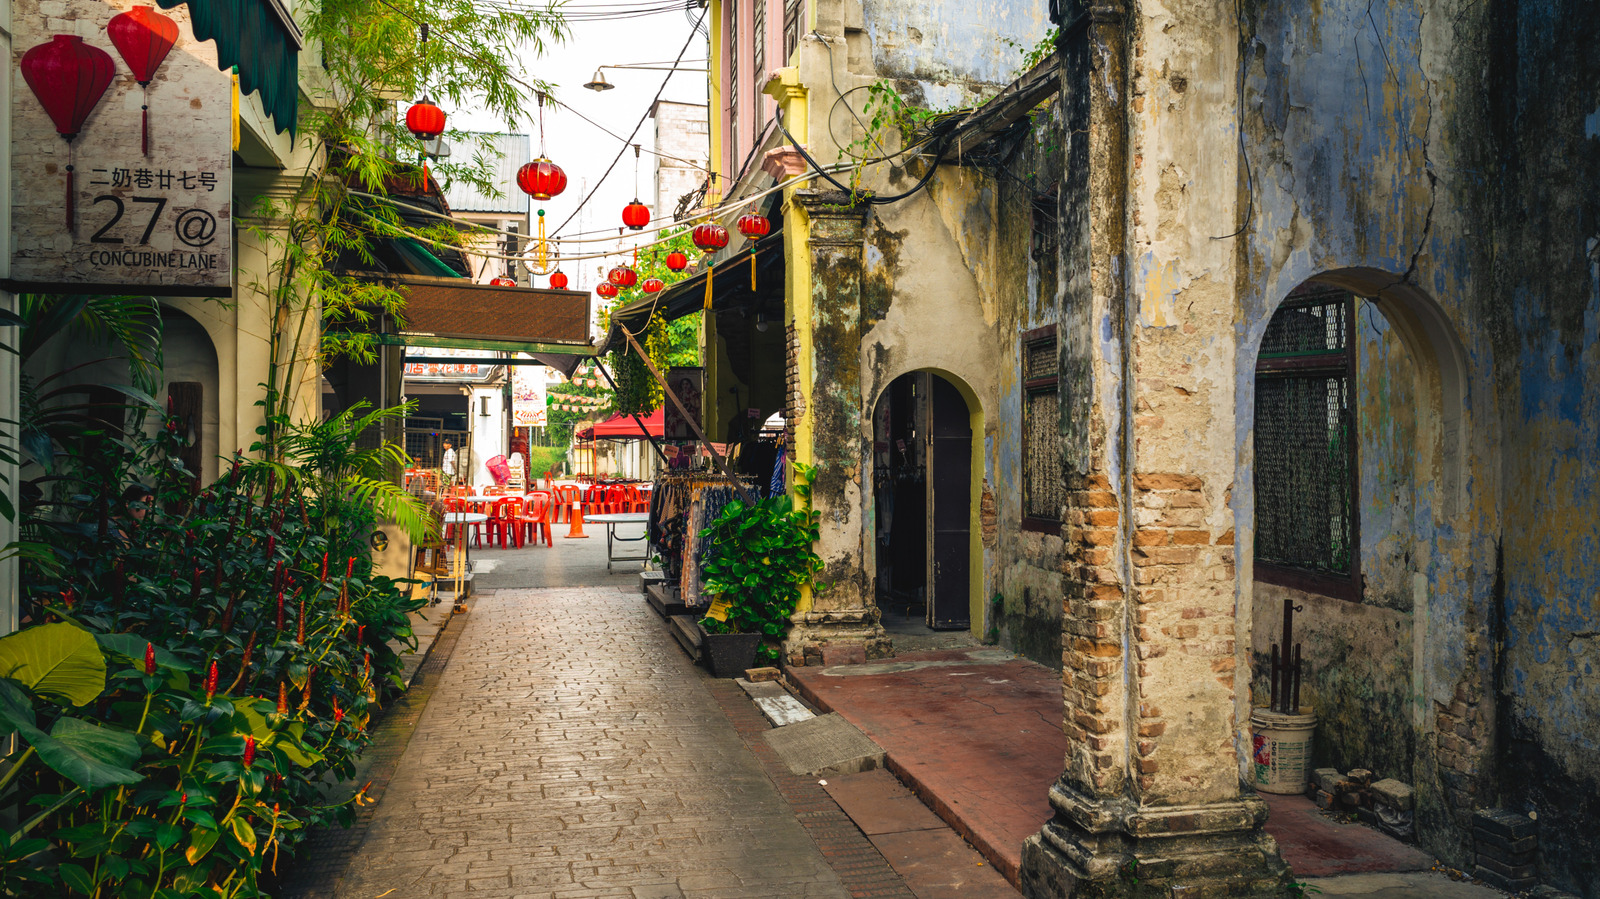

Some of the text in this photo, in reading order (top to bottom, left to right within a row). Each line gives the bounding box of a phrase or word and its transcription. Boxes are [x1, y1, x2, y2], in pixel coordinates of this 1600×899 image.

[90, 167, 218, 192] 二奶巷廿七号
[90, 250, 217, 270] CONCUBINE LANE
